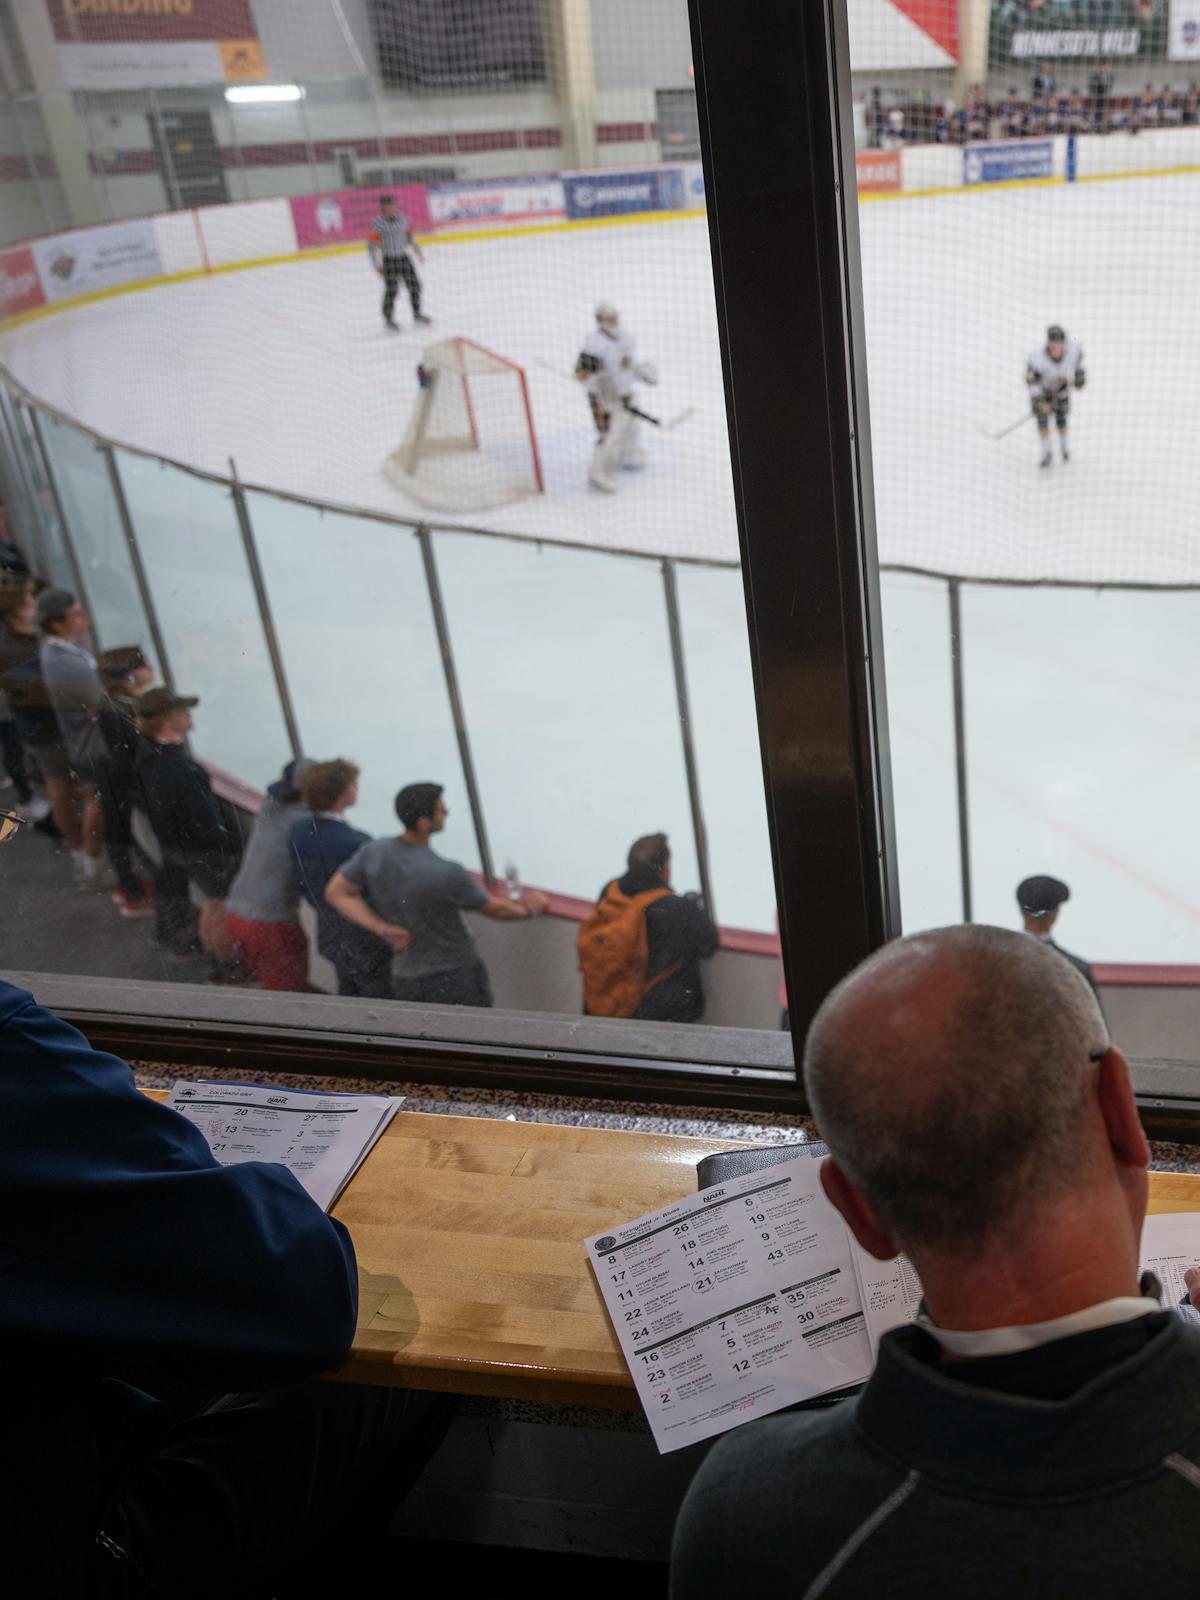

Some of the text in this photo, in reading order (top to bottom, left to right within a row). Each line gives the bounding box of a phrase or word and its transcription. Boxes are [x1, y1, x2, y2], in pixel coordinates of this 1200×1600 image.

[703, 1189, 727, 1203] NAHL
[745, 1198, 753, 1206] 6
[749, 1213, 765, 1224] 19
[619, 1219, 652, 1237] Springfield
[673, 1223, 689, 1236] 26
[761, 1232, 770, 1241] 9
[681, 1240, 697, 1252] 18
[608, 1255, 617, 1264] 8
[767, 1249, 783, 1261] 43
[688, 1258, 705, 1269] 14
[611, 1271, 626, 1282] 17
[695, 1278, 712, 1290] 21
[618, 1289, 633, 1301] 11
[787, 1291, 805, 1304] 35
[625, 1308, 642, 1321] 22
[797, 1311, 815, 1324] 30
[718, 1321, 727, 1331] 7
[631, 1327, 649, 1341] 24
[727, 1338, 736, 1348] 5
[641, 1352, 659, 1364] 16
[732, 1359, 751, 1372] 12
[647, 1369, 666, 1382] 23
[660, 1393, 670, 1404] 2
